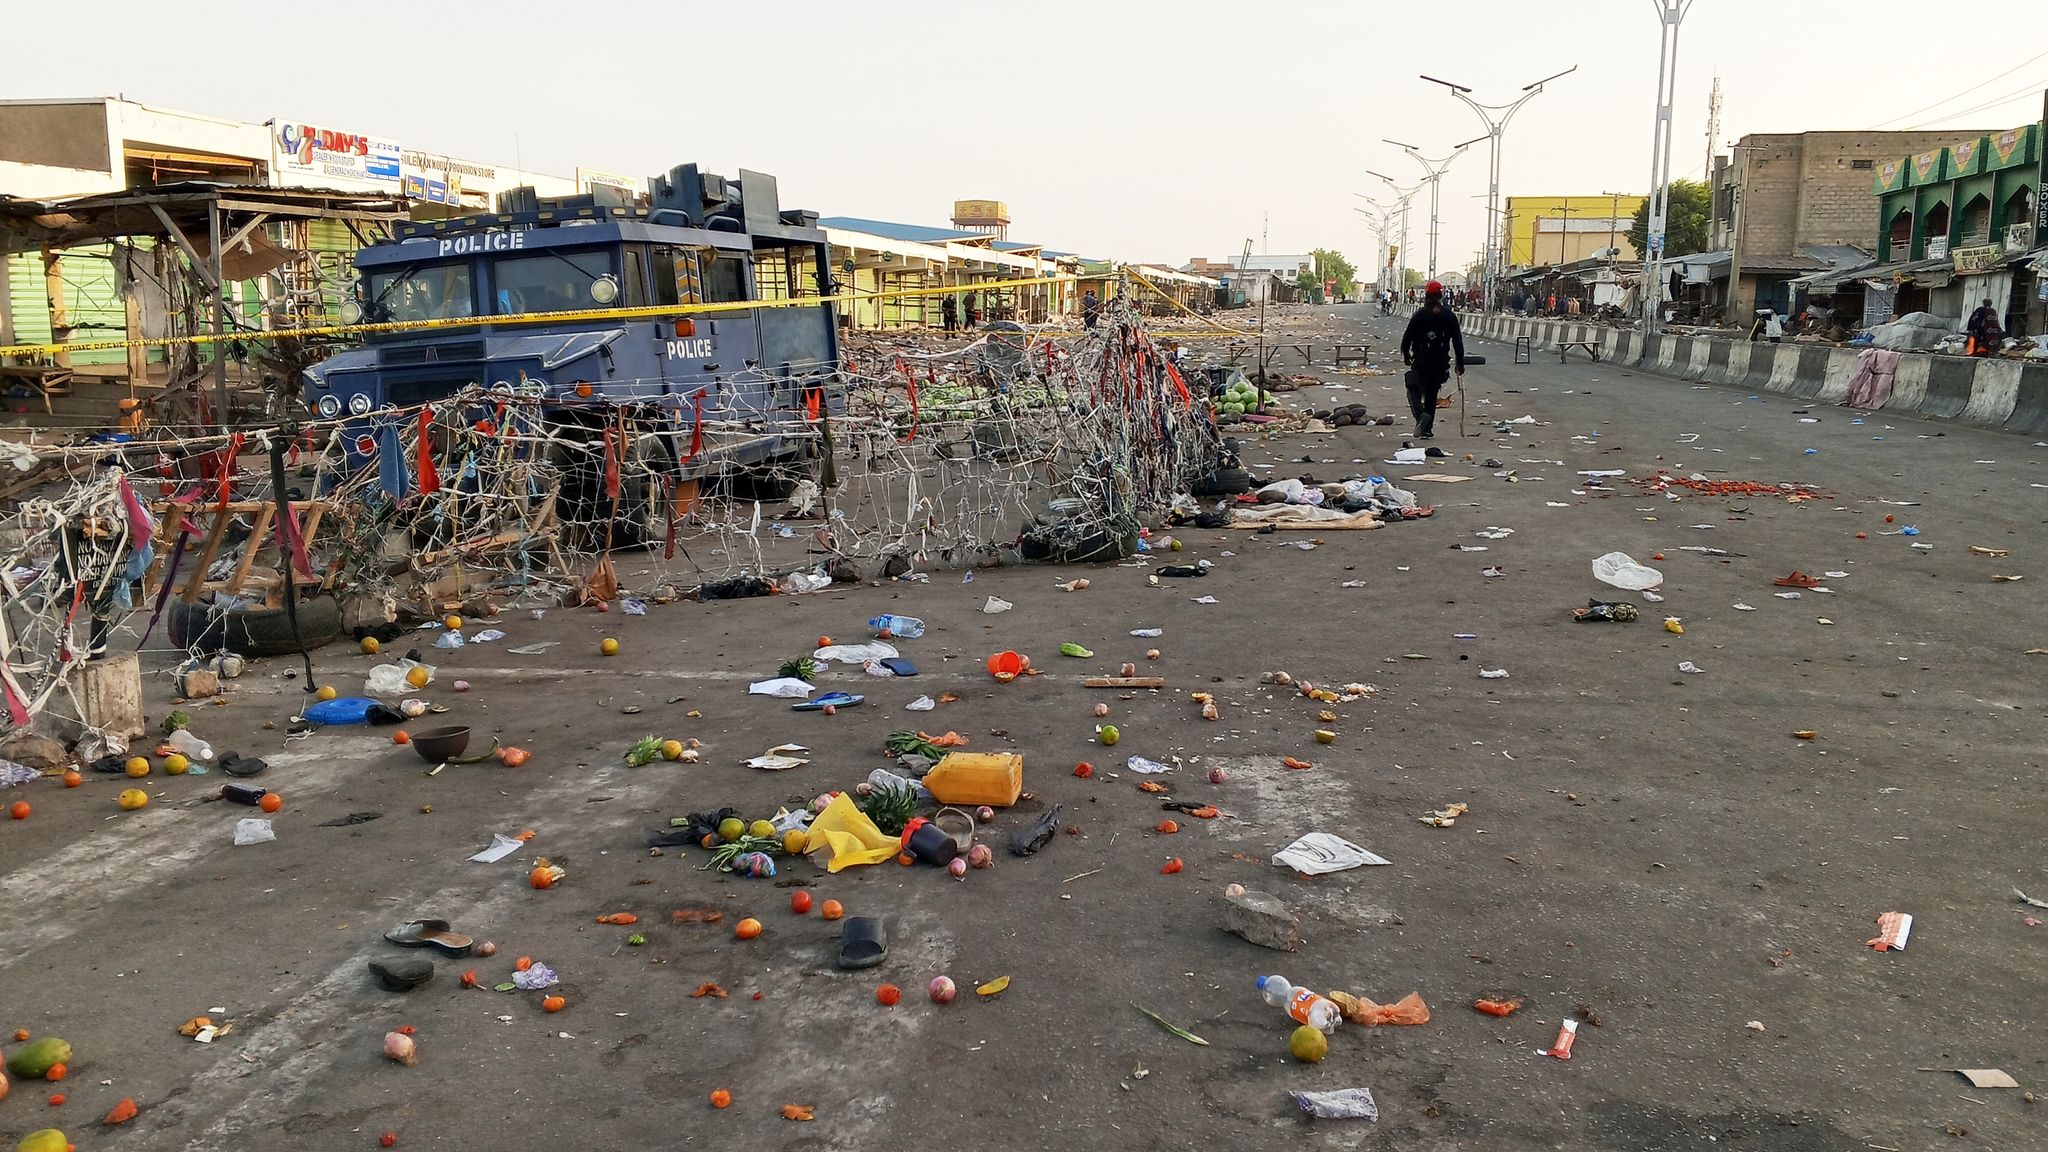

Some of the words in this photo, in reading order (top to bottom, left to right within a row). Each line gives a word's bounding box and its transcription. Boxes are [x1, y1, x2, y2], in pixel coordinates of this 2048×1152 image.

[449, 162, 477, 176] PROVISION
[478, 167, 495, 179] STORE
[439, 232, 523, 256] POLICE
[667, 338, 712, 360] POLICE
